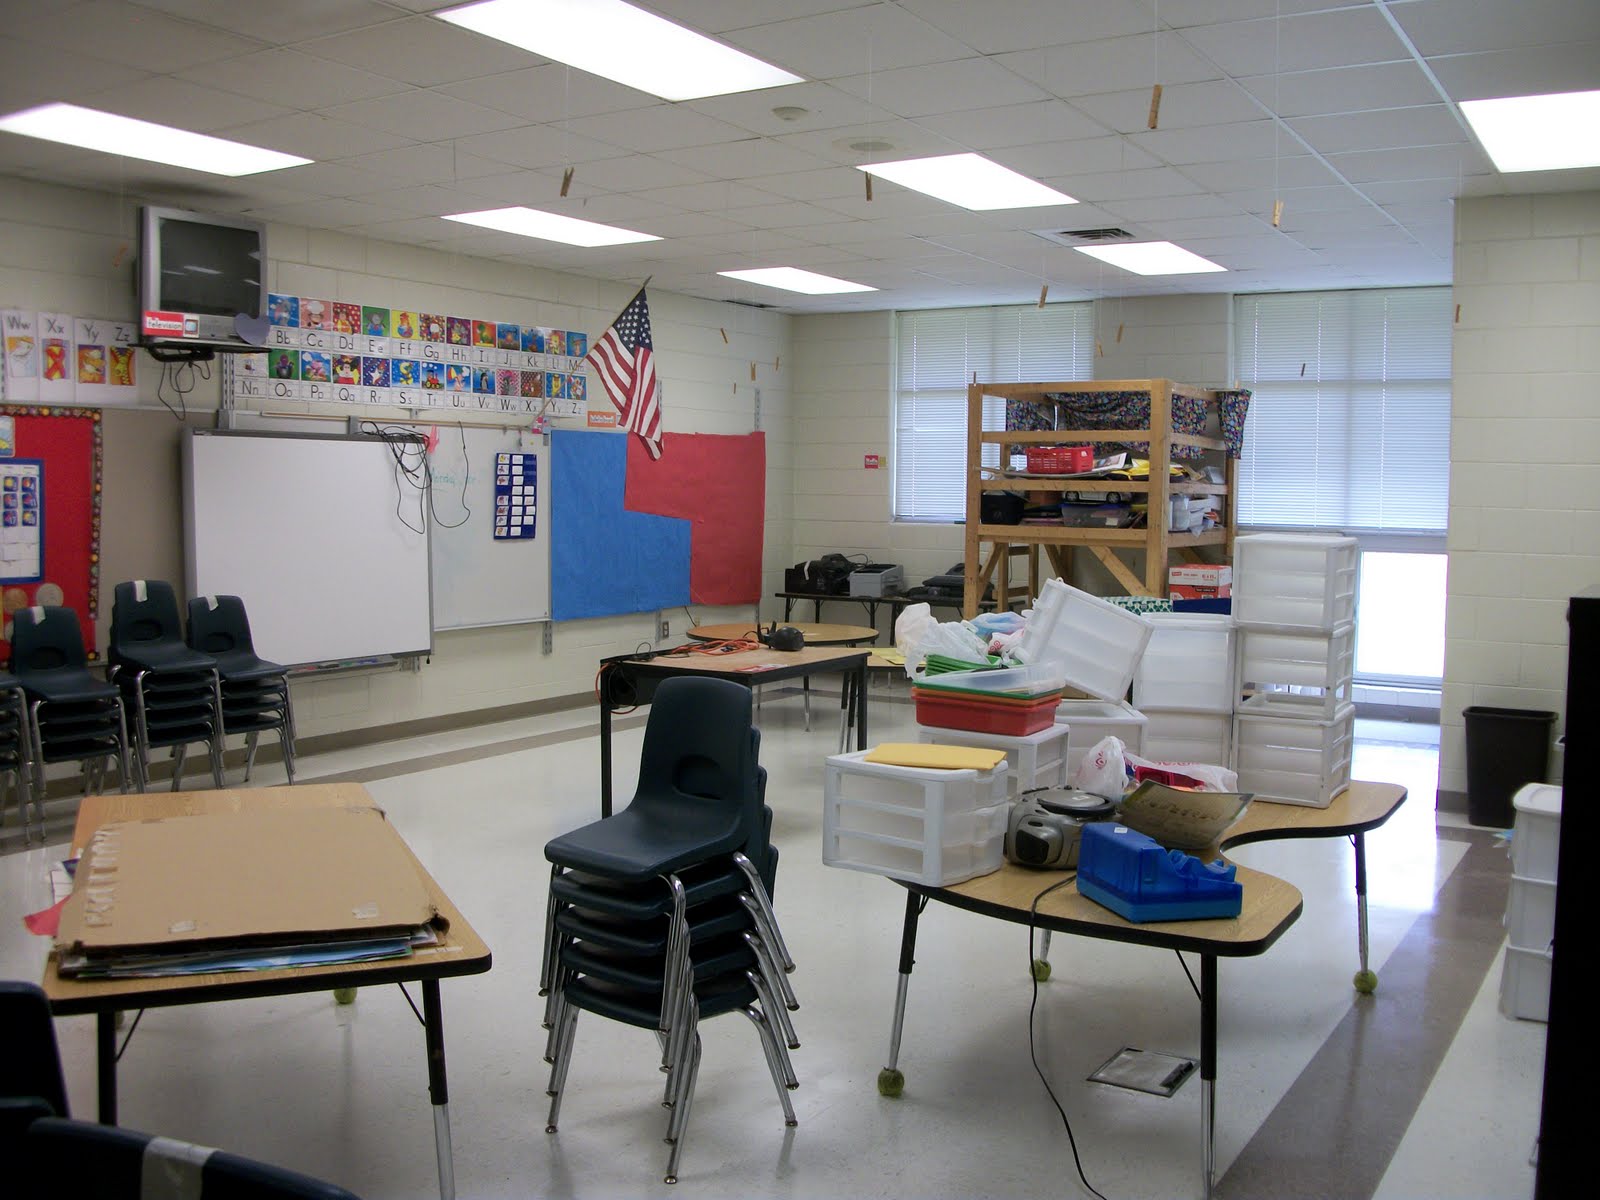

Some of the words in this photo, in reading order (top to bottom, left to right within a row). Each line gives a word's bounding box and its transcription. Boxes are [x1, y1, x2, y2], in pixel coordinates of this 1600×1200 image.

[8, 316, 31, 330] Ww
[47, 319, 65, 334] Xx
[147, 320, 183, 330] television
[84, 323, 100, 343] Yy
[115, 326, 130, 342] Zz
[276, 330, 290, 345] Bb
[306, 333, 323, 348] Cc
[339, 336, 354, 350] Dd
[368, 339, 384, 354] Ee
[400, 342, 412, 355] Ff
[424, 345, 439, 361] Gg
[452, 348, 467, 361] Hh
[479, 350, 489, 362] Ii
[504, 352, 513, 367] Jj
[527, 355, 539, 368] Kk
[242, 381, 259, 395] Nn
[275, 382, 293, 398] Oo
[310, 385, 324, 400] Pp
[370, 389, 382, 403] Rr
[399, 391, 412, 405] Ss
[426, 393, 437, 406] Tt
[452, 395, 466, 408] Uu
[478, 396, 490, 409] Vv
[501, 398, 516, 411] Ww
[525, 400, 537, 412] Xx
[551, 401, 561, 414] Yy
[572, 402, 581, 414] Zz
